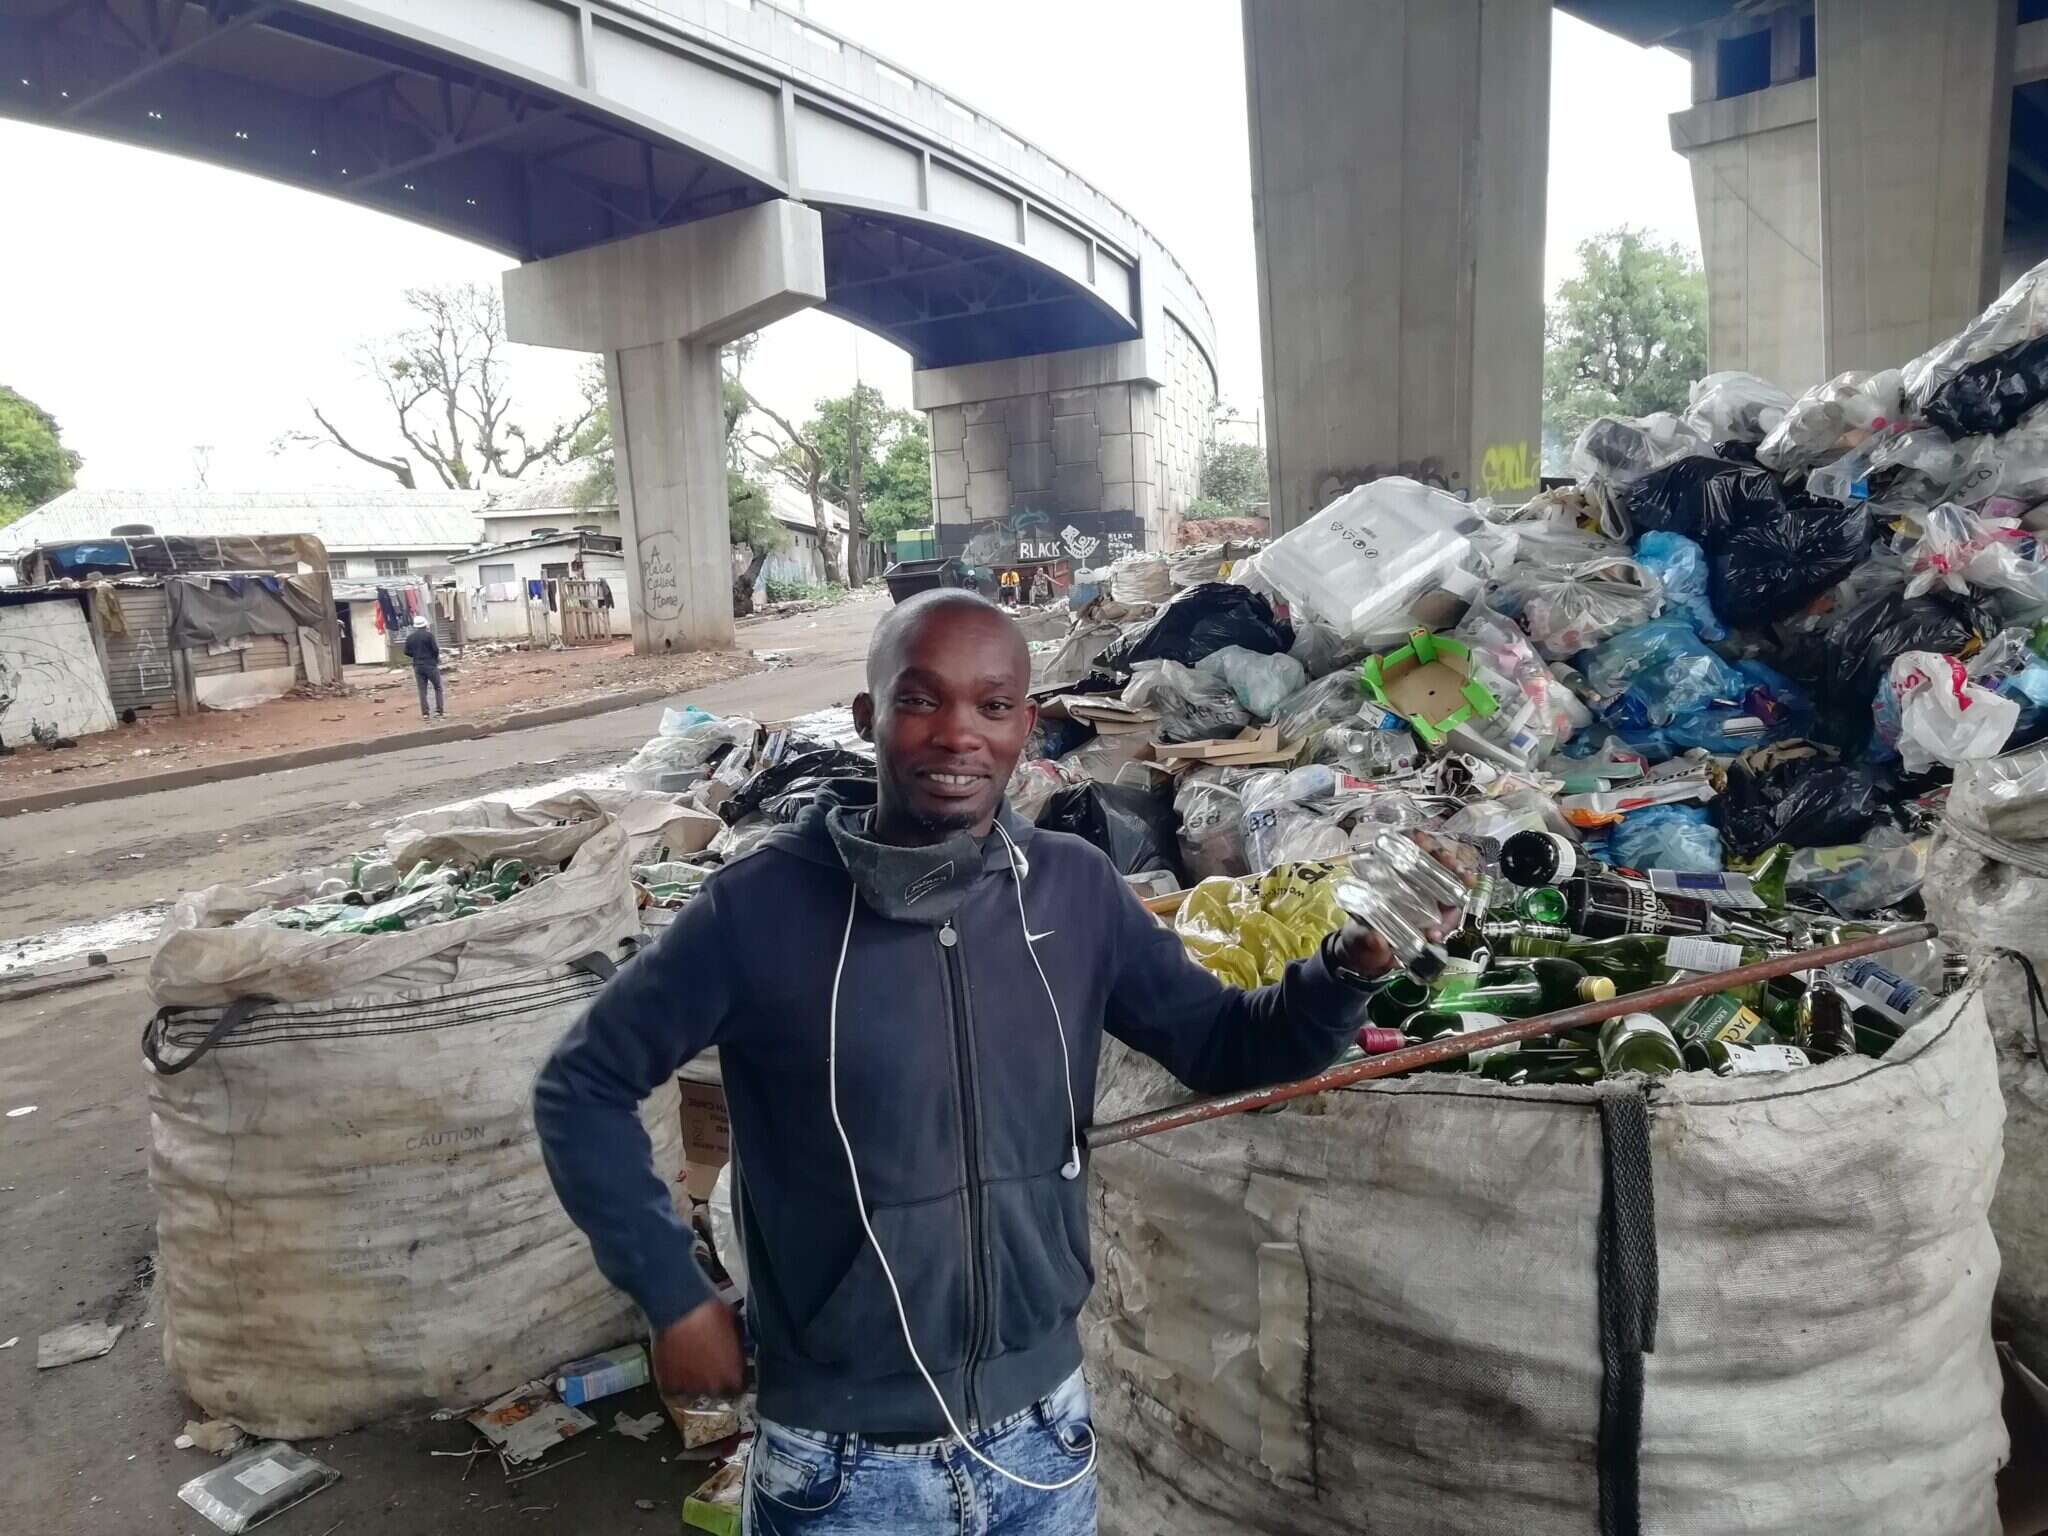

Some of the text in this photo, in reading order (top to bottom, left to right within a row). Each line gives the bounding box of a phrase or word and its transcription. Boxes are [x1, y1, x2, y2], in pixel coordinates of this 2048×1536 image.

[650, 544, 661, 563] A
[1019, 541, 1061, 560] BLACK
[405, 1126, 486, 1151] CAUTION
